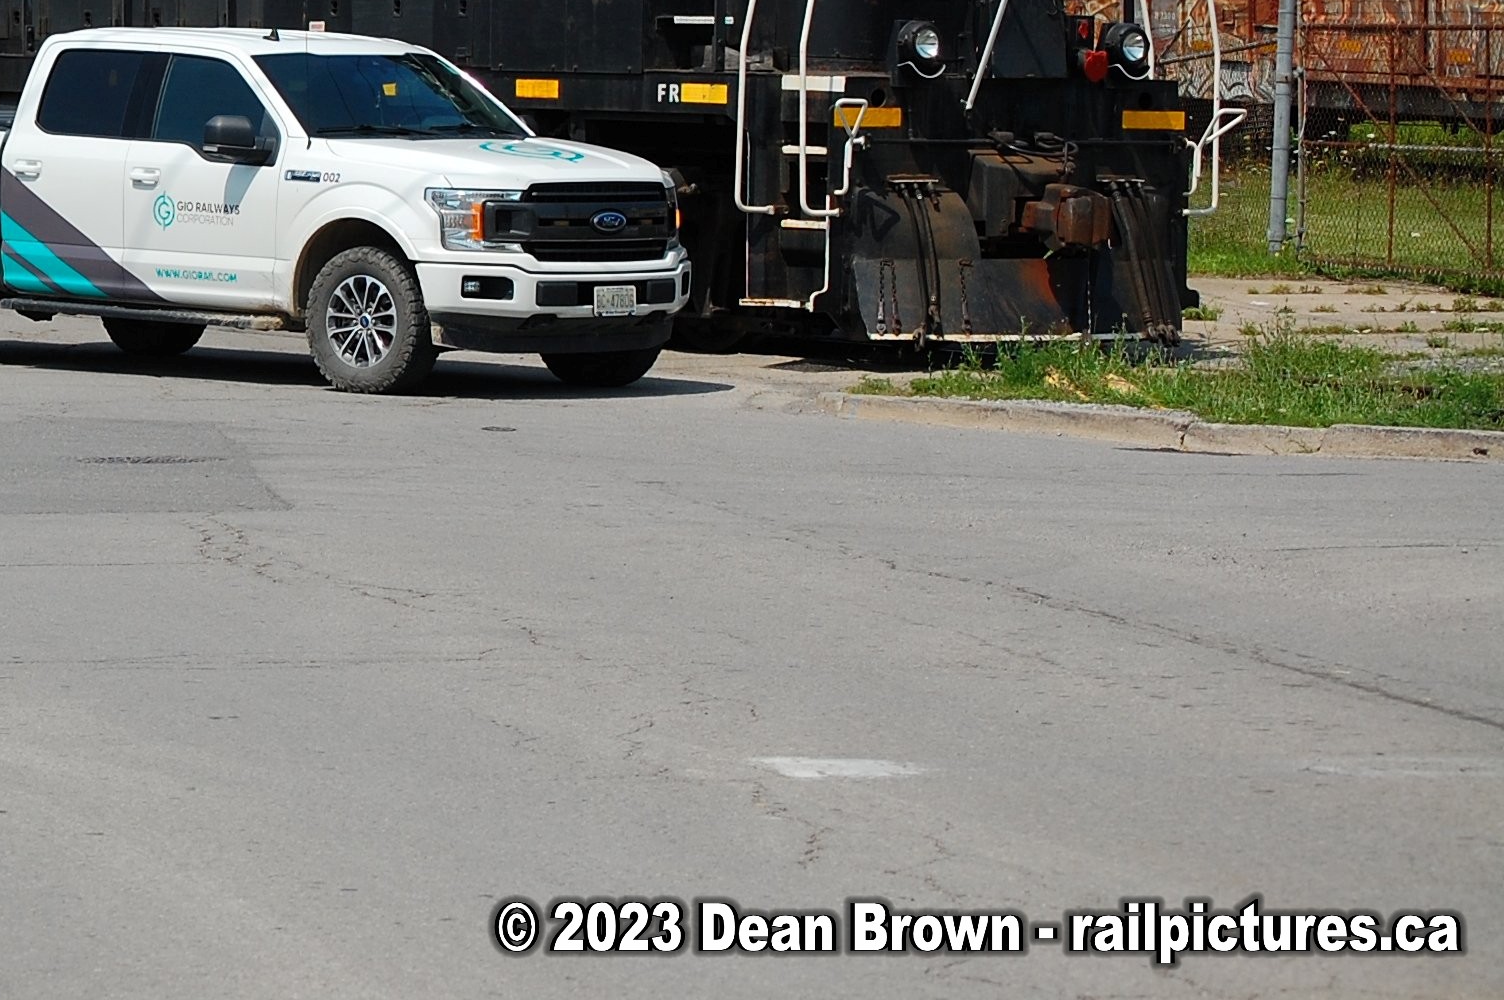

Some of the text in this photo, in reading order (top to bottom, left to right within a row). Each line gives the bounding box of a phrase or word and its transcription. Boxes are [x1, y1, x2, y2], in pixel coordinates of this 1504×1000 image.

[657, 83, 680, 103] FR
[323, 172, 341, 183] 002
[176, 201, 240, 215] GIO RAILWAYS
[176, 213, 234, 226] CORPORATION
[155, 268, 237, 283] WWW.GIORAIL.COM
